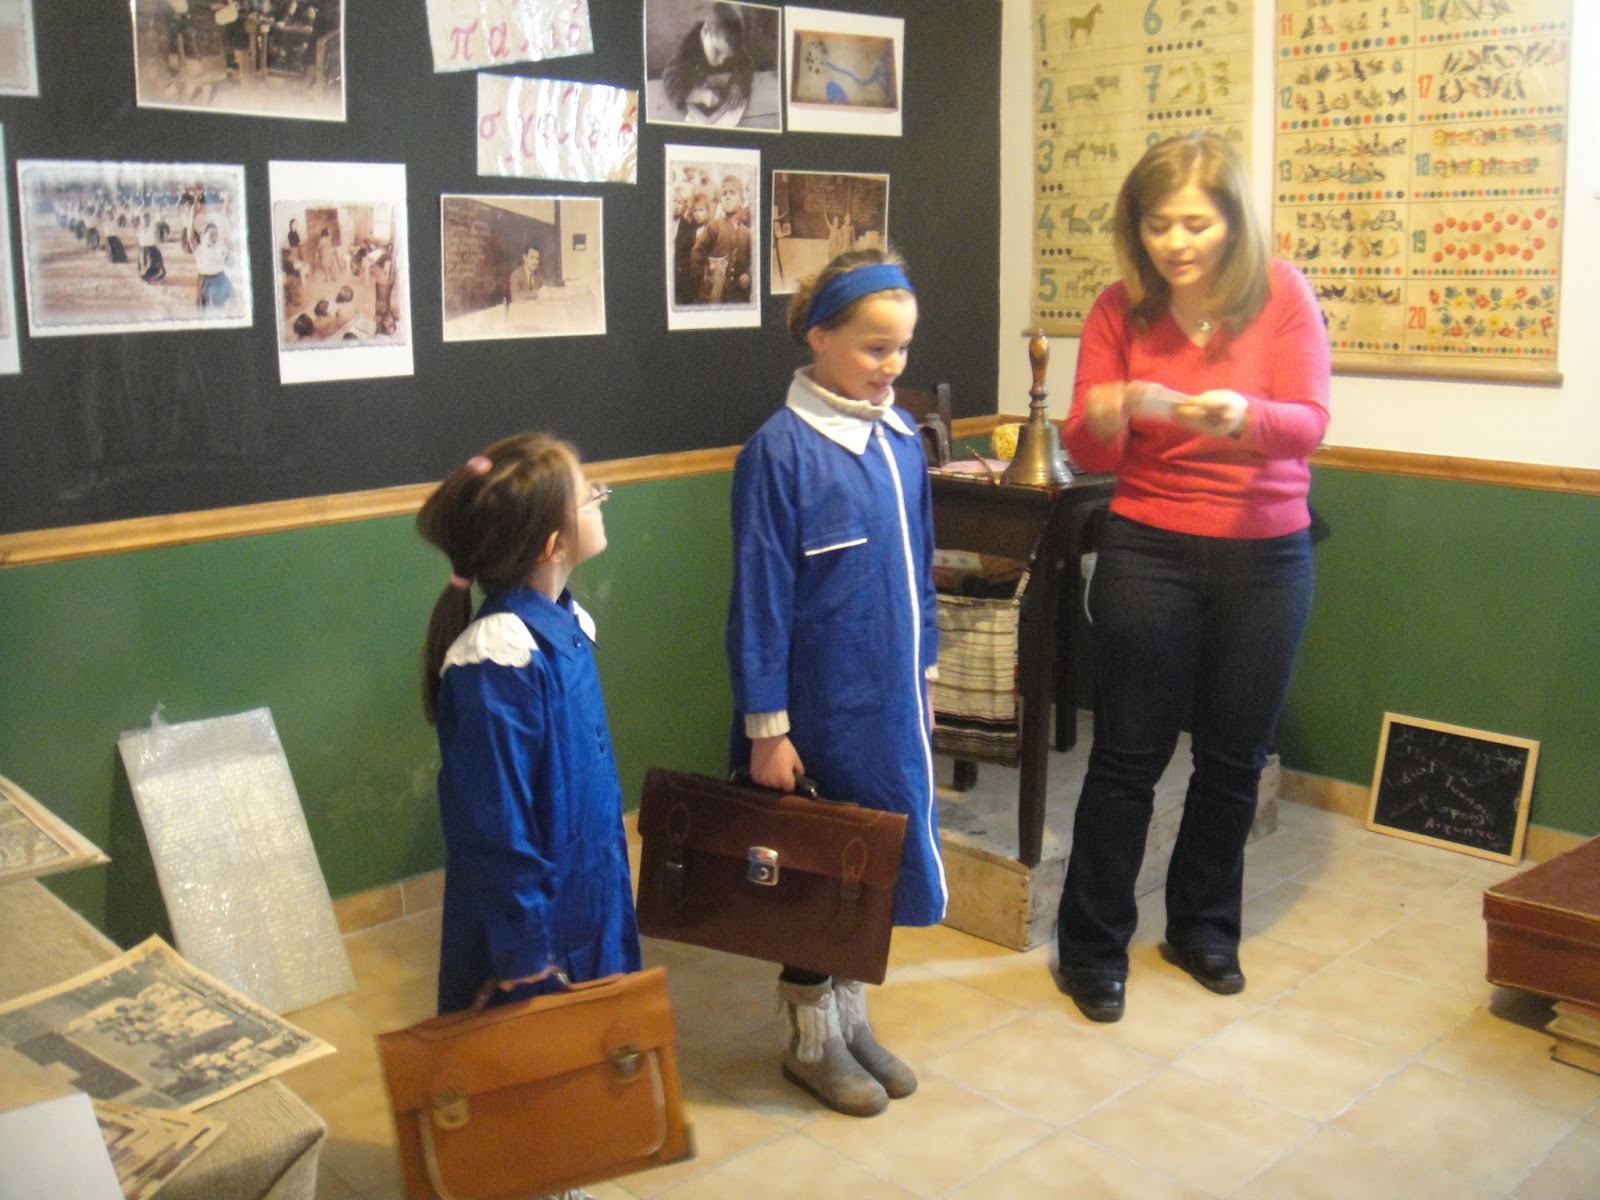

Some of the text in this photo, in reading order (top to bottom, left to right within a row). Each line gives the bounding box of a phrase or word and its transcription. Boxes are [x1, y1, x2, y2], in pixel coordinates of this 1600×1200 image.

[1143, 0, 1163, 36] 6
[1280, 14, 1293, 36] 11
[1038, 14, 1047, 51] 1
[1038, 77, 1055, 114] 2
[1143, 64, 1163, 104] 7
[1417, 74, 1433, 98] 17
[1280, 86, 1293, 110] 12
[1038, 140, 1055, 174] 3
[1415, 153, 1430, 176] 18
[1279, 160, 1292, 182] 13
[1038, 204, 1056, 240] 4
[1276, 232, 1291, 254] 14
[1412, 229, 1426, 253] 19
[1038, 268, 1057, 302] 5
[1408, 306, 1426, 330] 20
